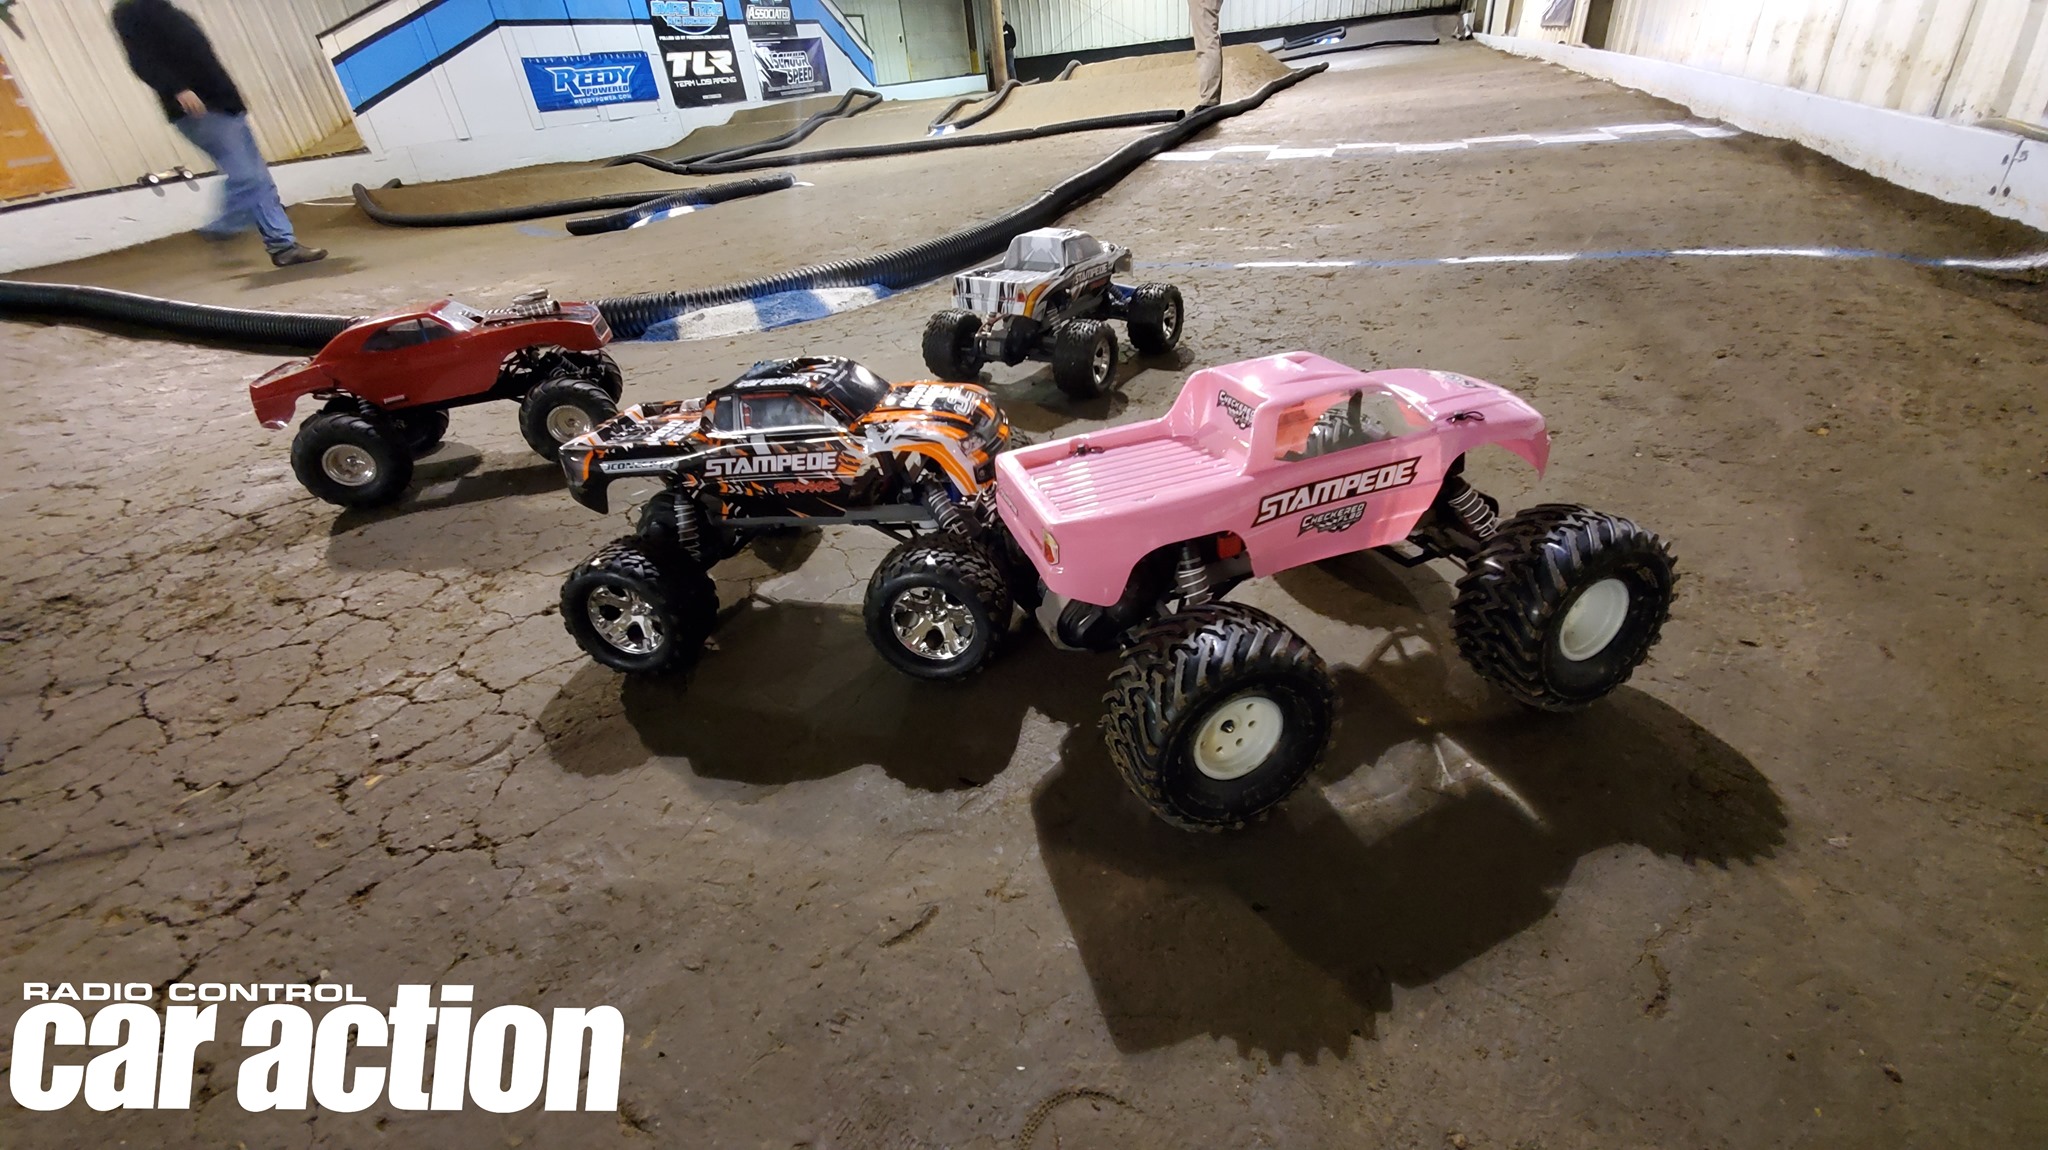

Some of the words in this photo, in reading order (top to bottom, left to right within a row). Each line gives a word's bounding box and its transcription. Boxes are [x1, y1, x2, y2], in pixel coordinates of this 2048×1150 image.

[748, 6, 790, 20] ASSOCIATED
[666, 50, 734, 77] TLR
[788, 67, 813, 84] SPEED
[546, 66, 635, 97] REEDY
[586, 85, 629, 96] POWERED
[674, 80, 695, 88] TEAM
[696, 78, 712, 86] LOSI
[713, 76, 737, 85] RACING
[1075, 262, 1108, 285] STAMPEDE
[704, 451, 838, 477] STAMPEDE
[1256, 460, 1416, 524] STAMPEDE
[1302, 503, 1364, 528] CHECKERED
